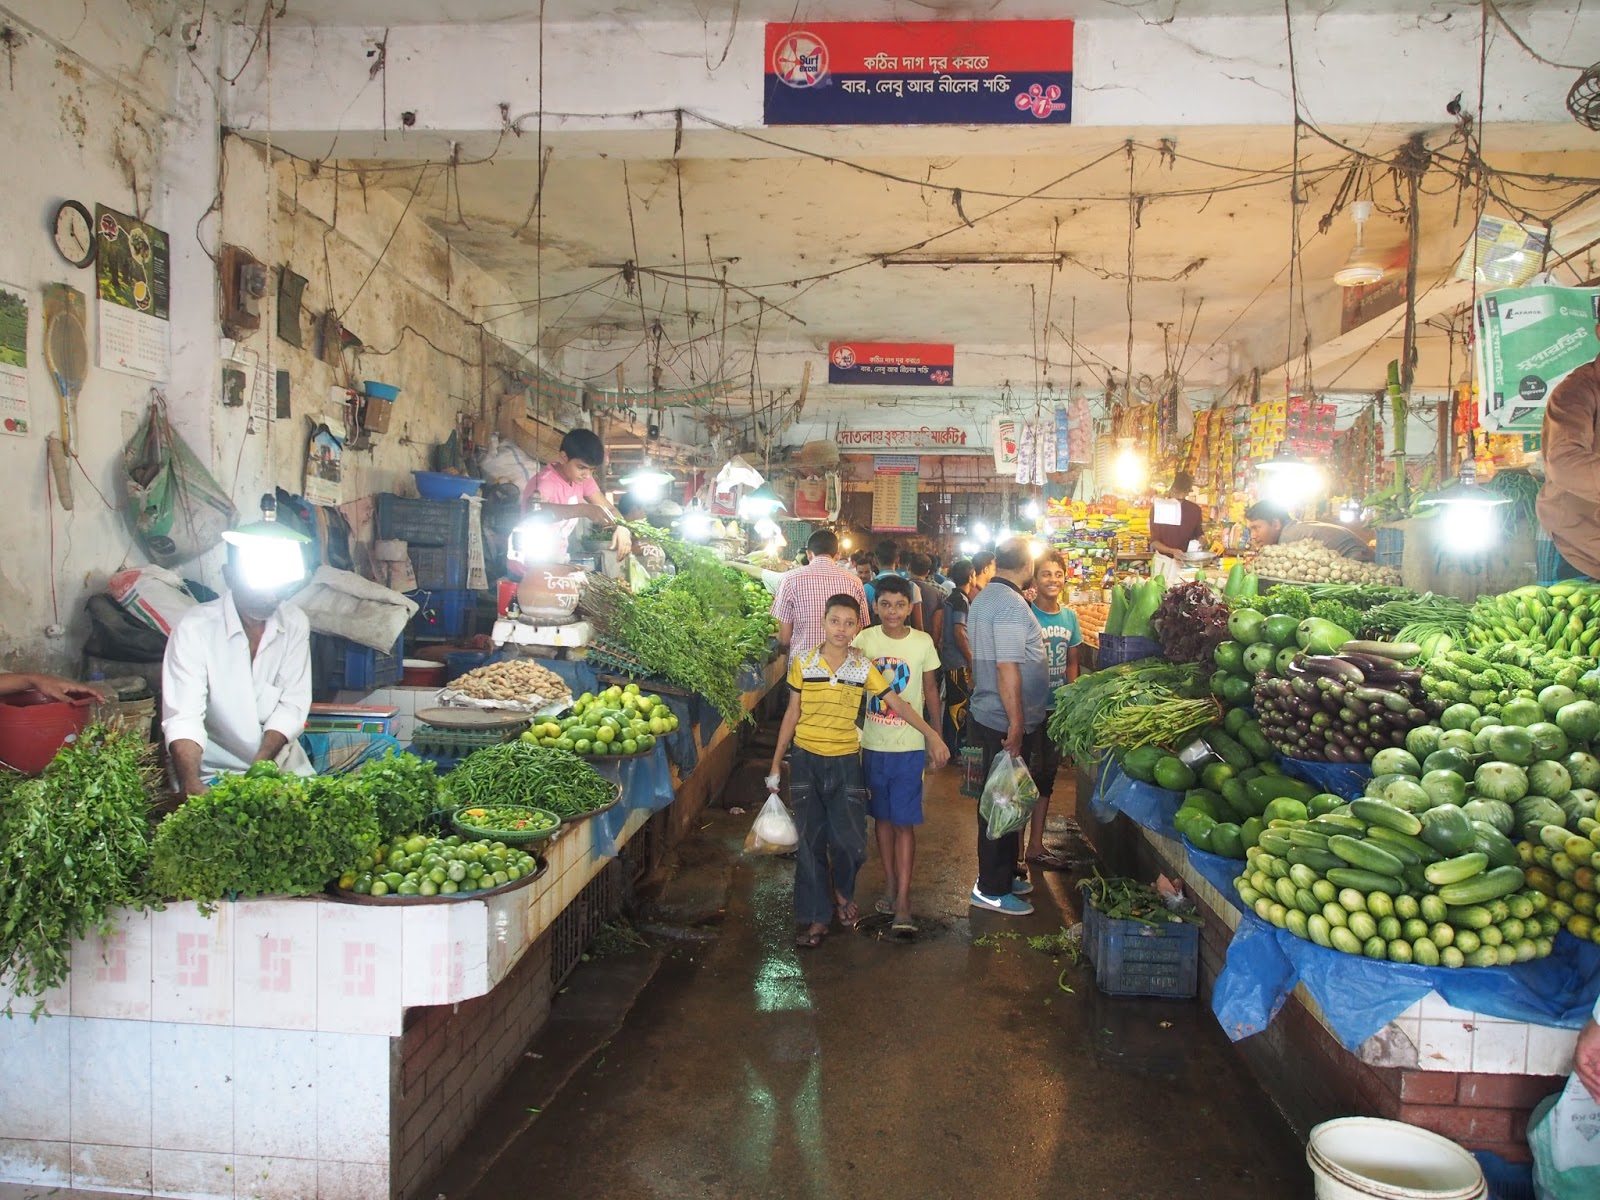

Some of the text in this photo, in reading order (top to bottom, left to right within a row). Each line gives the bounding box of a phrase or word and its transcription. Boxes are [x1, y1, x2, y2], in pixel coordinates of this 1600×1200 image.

[799, 55, 819, 65] Surf
[799, 64, 818, 72] excel
[864, 52, 989, 74] কঠিন দাগ দূর করতে
[841, 75, 1011, 97] বার, লেবু আর নীলের শক্তি
[931, 426, 960, 445] মার্কেট
[1041, 625, 1072, 641] OCCER
